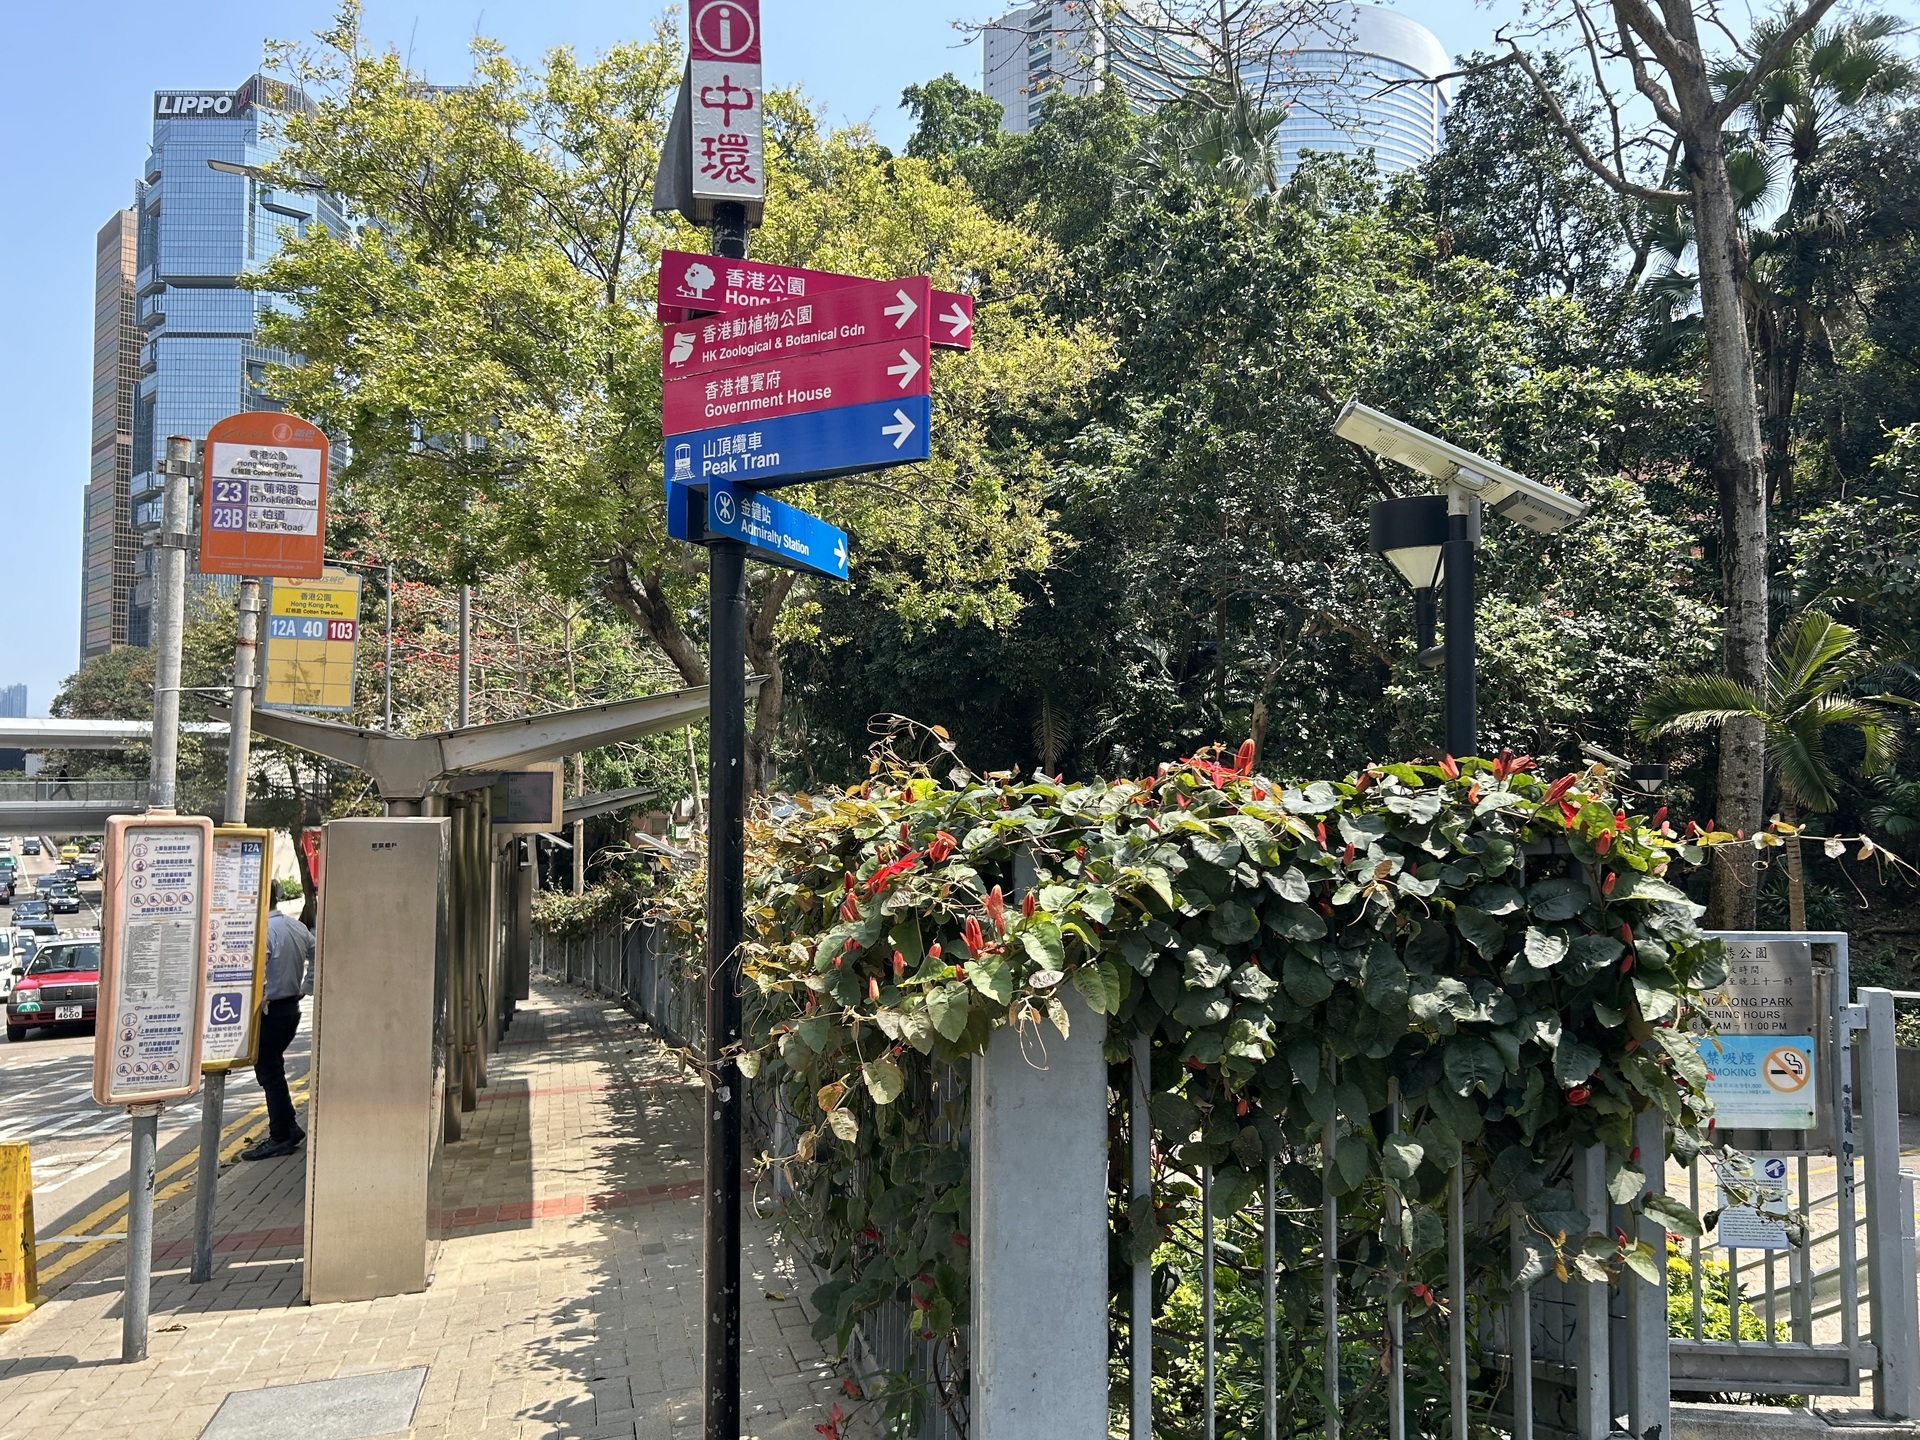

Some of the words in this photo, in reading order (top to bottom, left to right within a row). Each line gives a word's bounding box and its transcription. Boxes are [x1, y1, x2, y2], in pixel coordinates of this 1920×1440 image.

[158, 96, 232, 114] LIPPO
[700, 74, 756, 184] 中環
[725, 268, 805, 297] 香港公園
[725, 292, 771, 307] Hong
[702, 305, 812, 344] 香港動植物公園
[702, 350, 717, 363] HK
[719, 340, 772, 360] Zoological
[775, 336, 783, 349] &
[785, 326, 838, 347] Botanical
[840, 324, 865, 339] Gdn
[704, 370, 781, 401] 香港禮賓府
[704, 394, 784, 418] Government
[787, 386, 832, 404] House
[702, 431, 763, 459] 山頂纜車
[249, 449, 288, 461] 香港公園
[237, 460, 257, 469] Hong
[260, 461, 279, 469] Kong
[281, 461, 298, 470] Park
[702, 459, 737, 477] Peak
[741, 453, 780, 471] Tram
[216, 482, 242, 502] 23
[260, 495, 294, 504] Pokfield
[295, 497, 317, 506] Road
[213, 508, 243, 529] 23B
[262, 509, 285, 521] 柏道
[740, 498, 772, 525] 金鐘站
[260, 522, 279, 530] Park
[281, 523, 304, 531] Road
[740, 519, 782, 548] Admiralty
[783, 533, 810, 556] Station
[300, 592, 332, 602] 香港公園
[290, 601, 307, 609] Hong
[308, 601, 324, 610] Kong
[271, 619, 296, 637] 12A
[302, 621, 323, 637] 40
[330, 622, 353, 639] 103
[243, 843, 260, 853] 12A
[1726, 946, 1767, 960] 港公園
[1729, 997, 1757, 1006] ONG
[1761, 997, 1794, 1006] PARK
[57, 1011, 80, 1019] 4660
[1708, 1010, 1740, 1019] ENING
[1743, 1010, 1780, 1019] HOURS
[1716, 1022, 1731, 1030] AM
[1743, 1022, 1769, 1030] 11:00
[1771, 1022, 1787, 1030] PM
[1706, 1051, 1756, 1066] 禁吸煙
[1707, 1067, 1757, 1077] SMOKING
